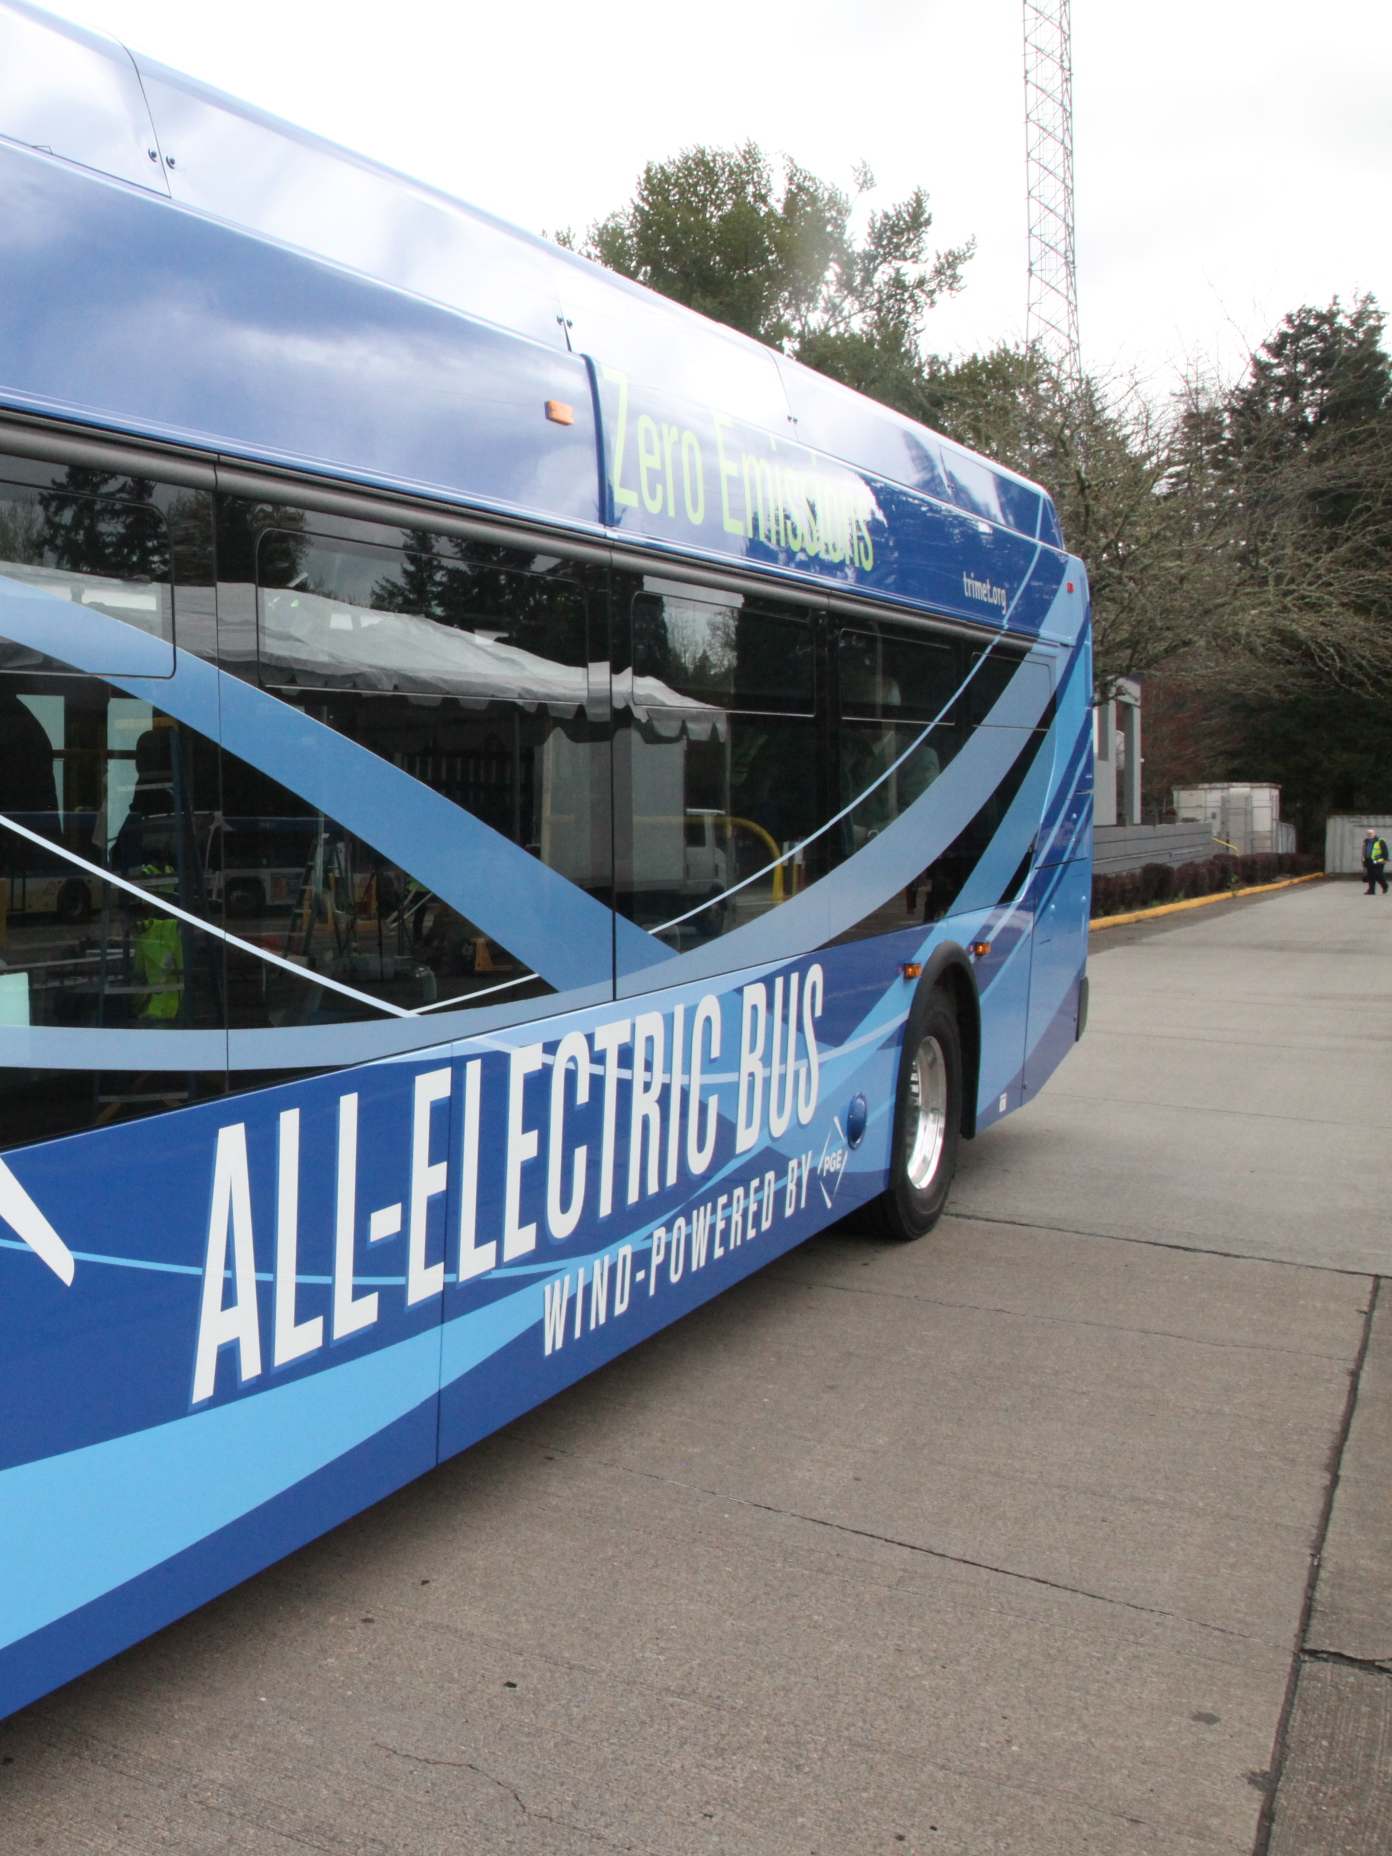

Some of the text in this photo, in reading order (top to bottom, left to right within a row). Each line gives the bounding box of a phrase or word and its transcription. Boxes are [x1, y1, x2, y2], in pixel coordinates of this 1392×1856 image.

[601, 364, 874, 572] Zero Emissions
[963, 571, 1007, 615] trimet.org
[191, 963, 824, 1405] ALL-ELECTRIC BUS
[543, 1148, 844, 1357] WIND-POWERED BY PGE
